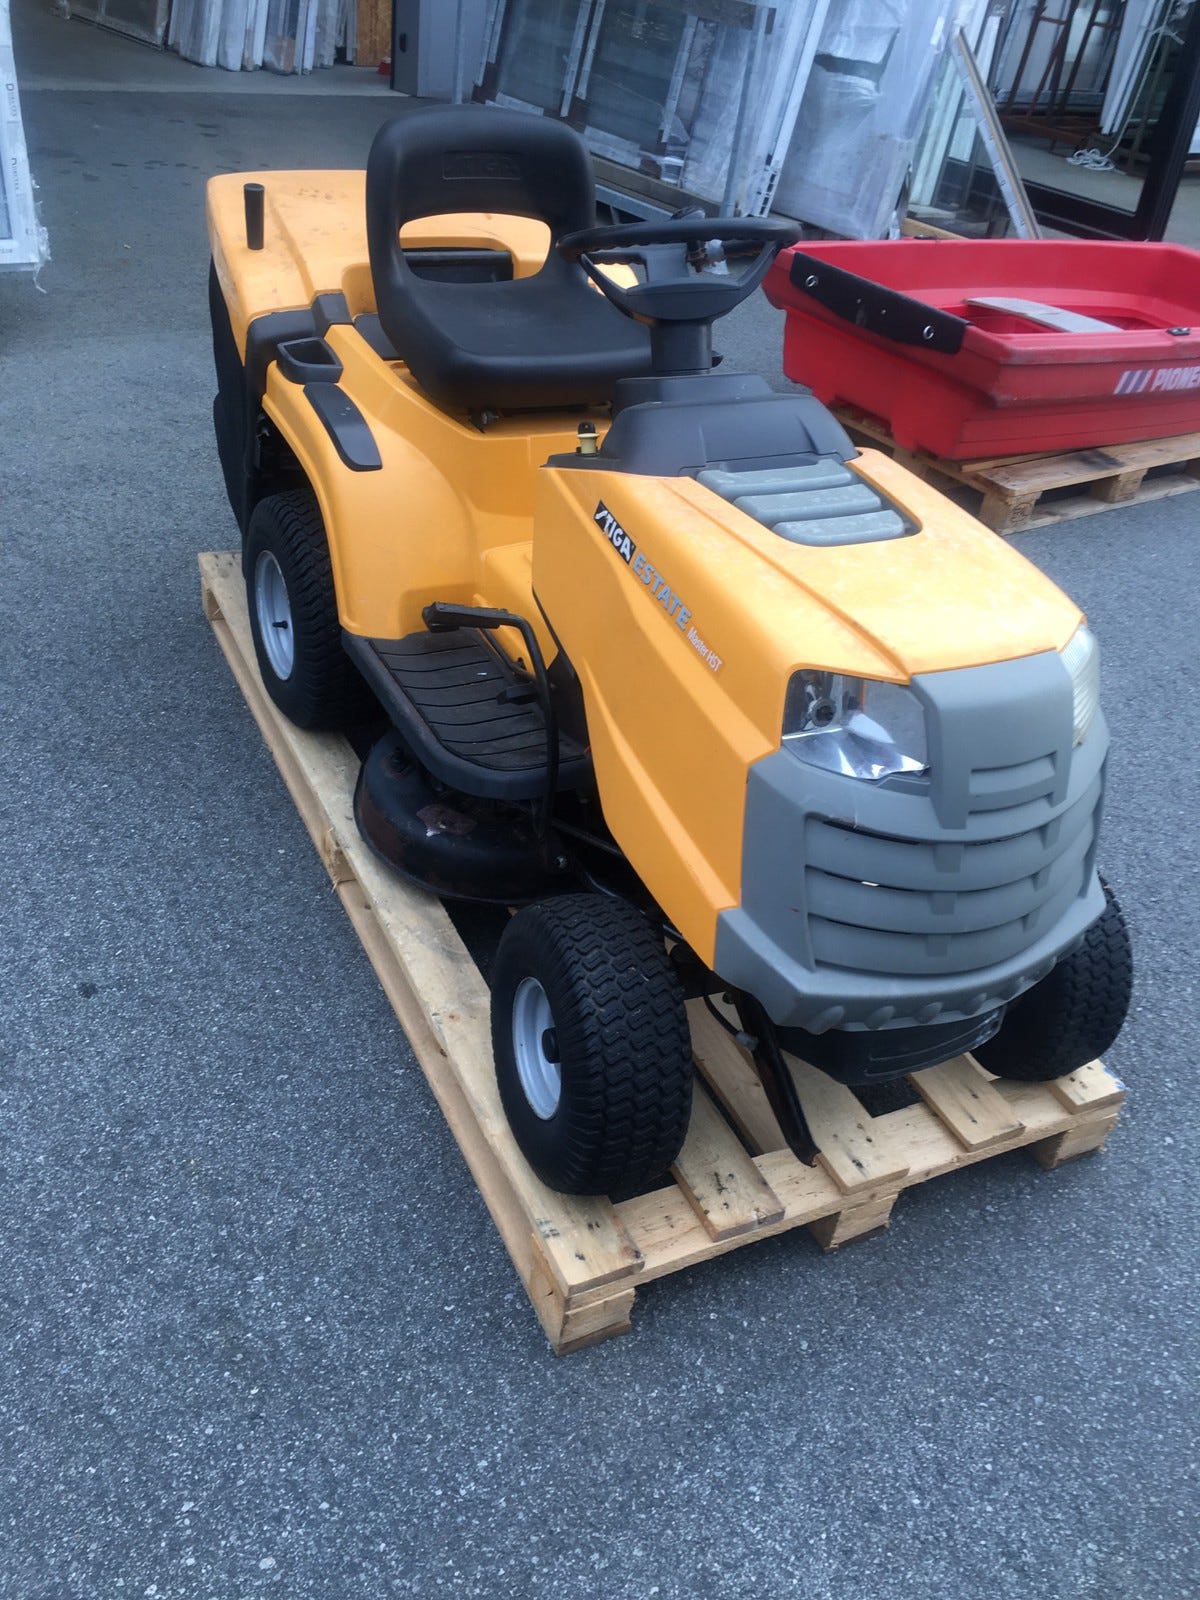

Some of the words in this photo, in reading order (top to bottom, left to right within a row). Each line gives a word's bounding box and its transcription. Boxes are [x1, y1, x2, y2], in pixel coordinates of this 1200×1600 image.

[594, 509, 634, 562] STIGA
[632, 552, 692, 631] ESTATE
[687, 627, 708, 656] Master
[706, 651, 723, 672] HST
